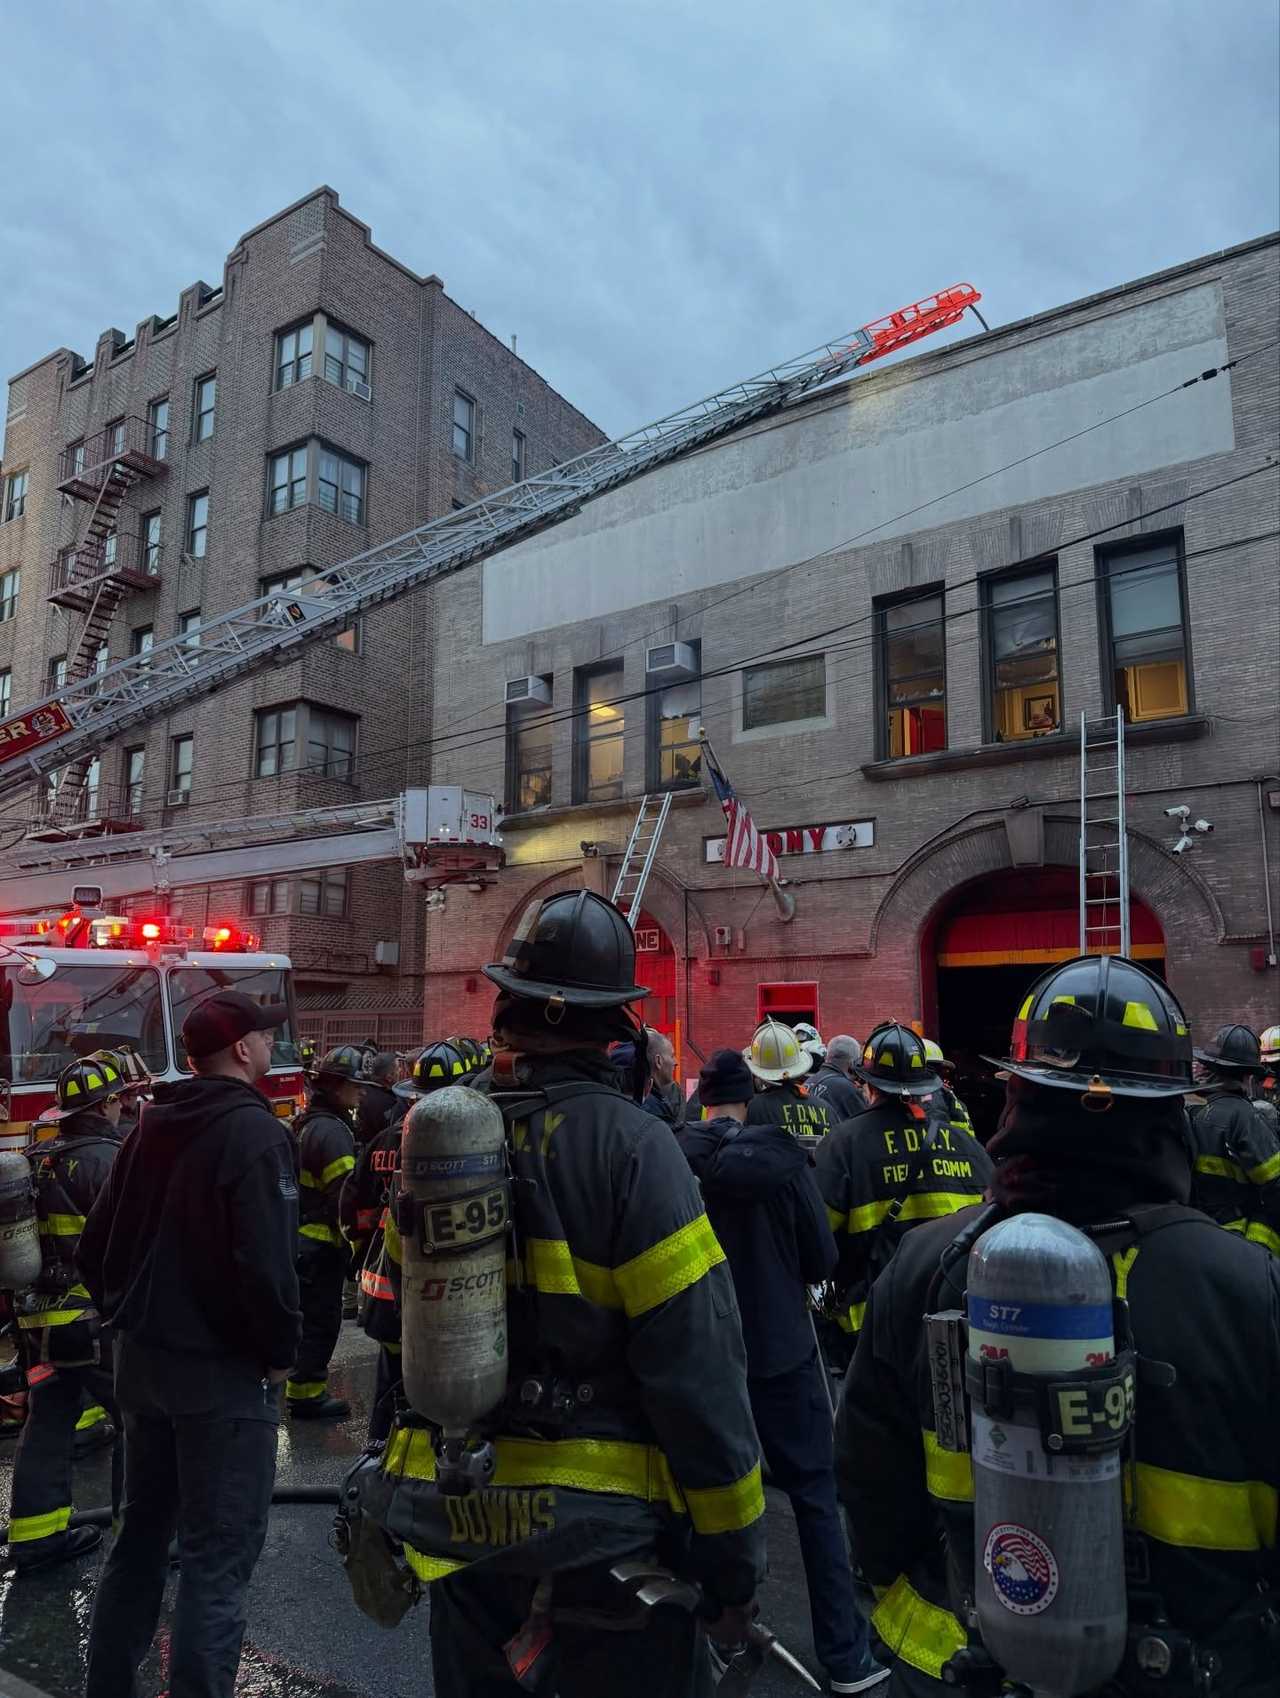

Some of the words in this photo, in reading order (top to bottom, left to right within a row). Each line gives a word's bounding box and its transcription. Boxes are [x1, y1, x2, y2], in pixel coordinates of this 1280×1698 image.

[471, 814, 488, 829] 33
[766, 825, 827, 857] DNY
[932, 1158, 973, 1178] COMM
[432, 1191, 504, 1243] E-95
[449, 1268, 503, 1292] SCOTT
[989, 1304, 1022, 1322] ST7
[447, 1489, 556, 1546] DOWNS
